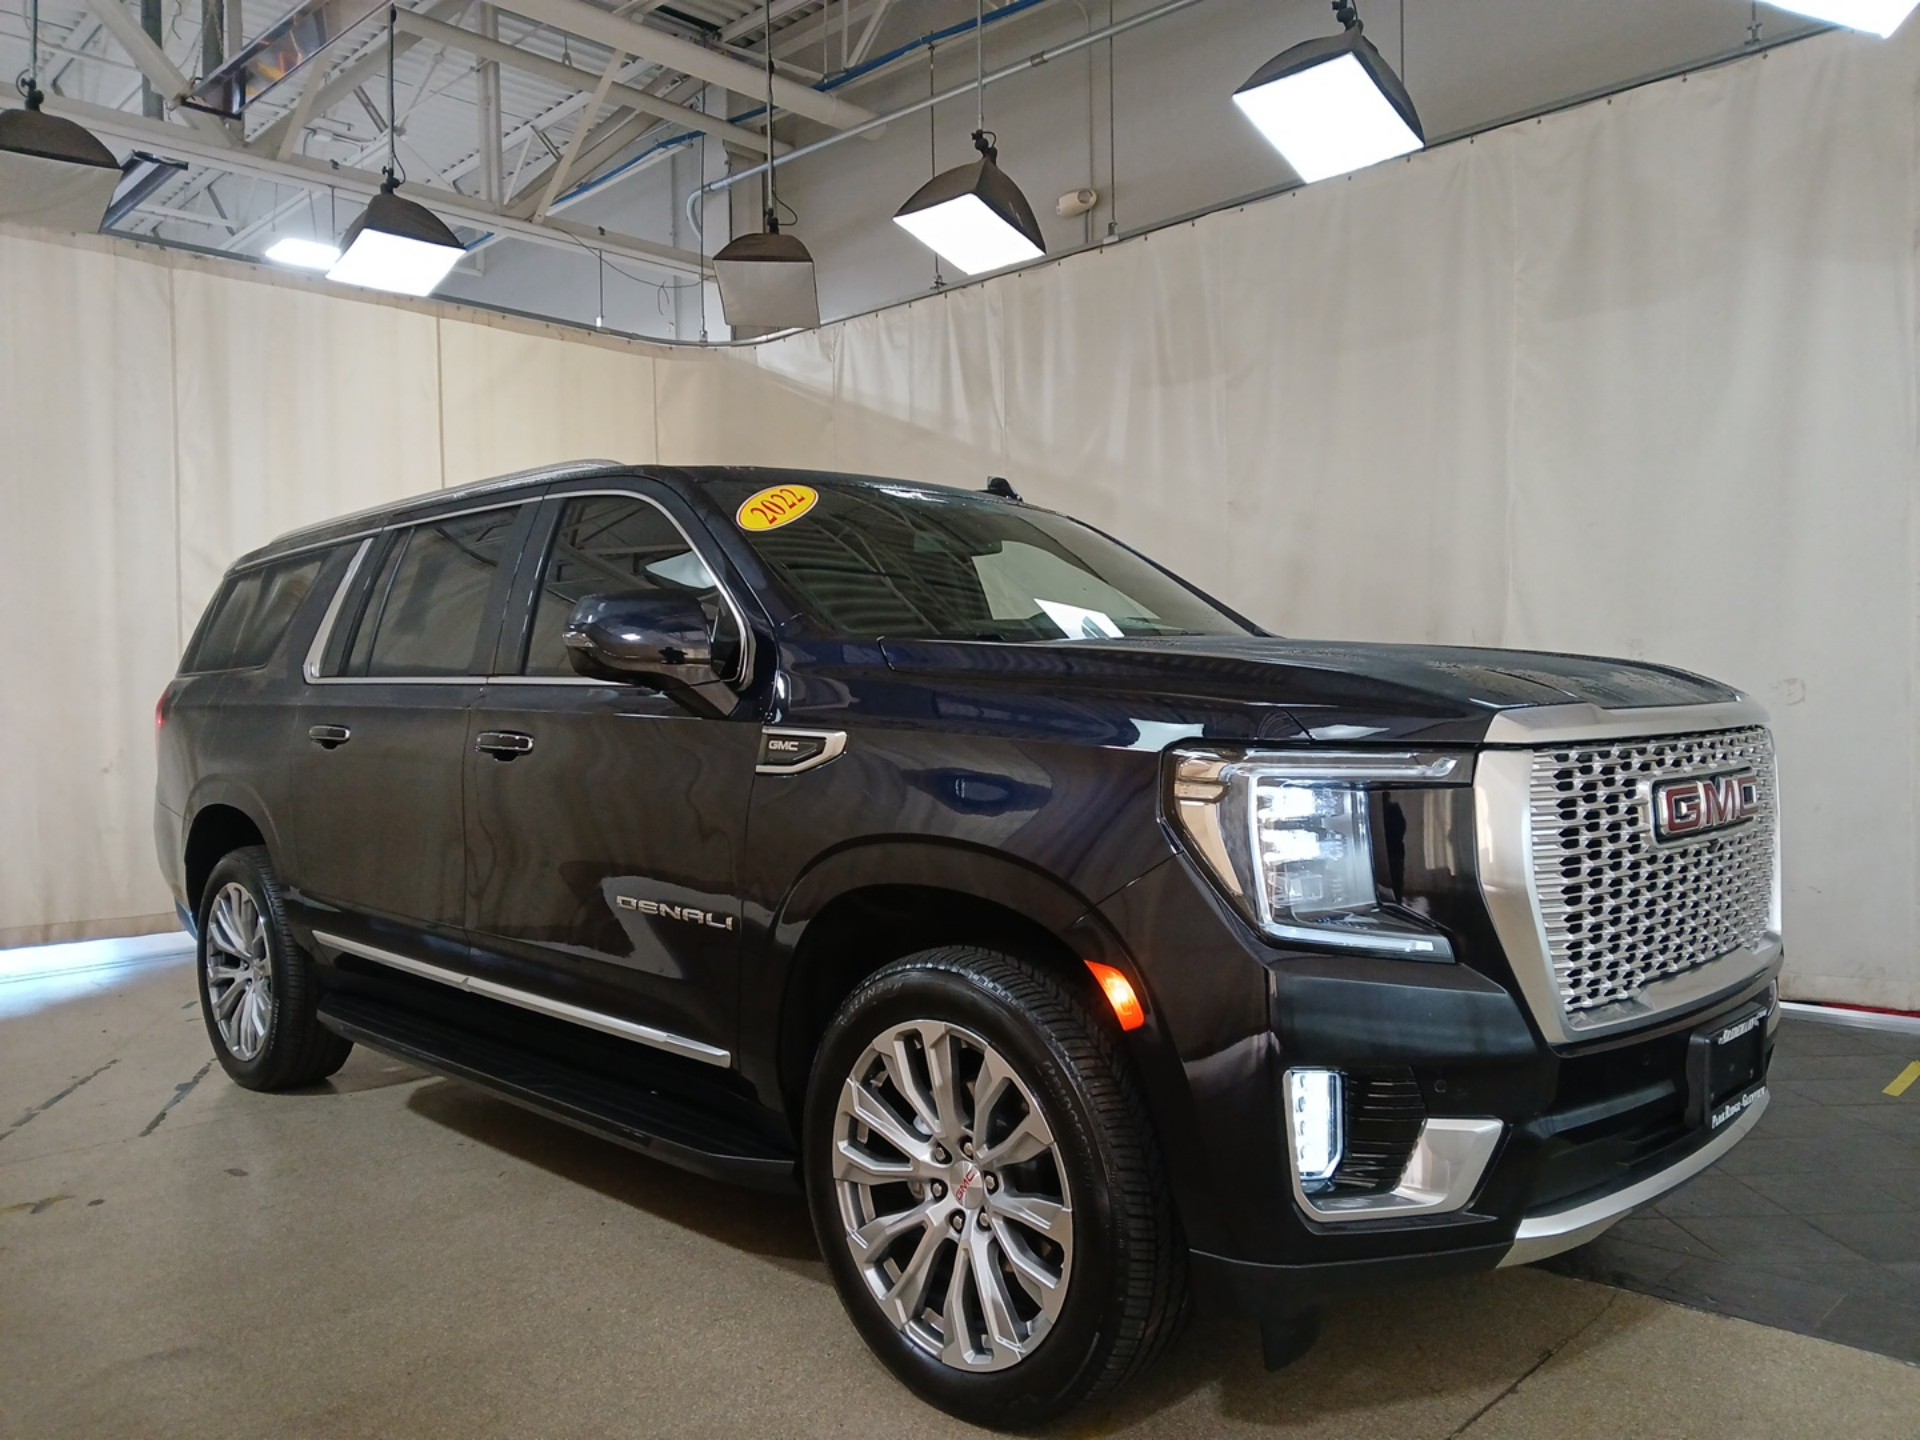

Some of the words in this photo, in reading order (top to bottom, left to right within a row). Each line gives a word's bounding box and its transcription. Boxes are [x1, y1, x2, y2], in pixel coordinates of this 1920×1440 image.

[750, 488, 806, 525] 2022
[768, 740, 799, 751] GMC
[1663, 775, 1760, 833] GMC
[616, 895, 733, 931] DENALI
[955, 1169, 976, 1201] GMC
